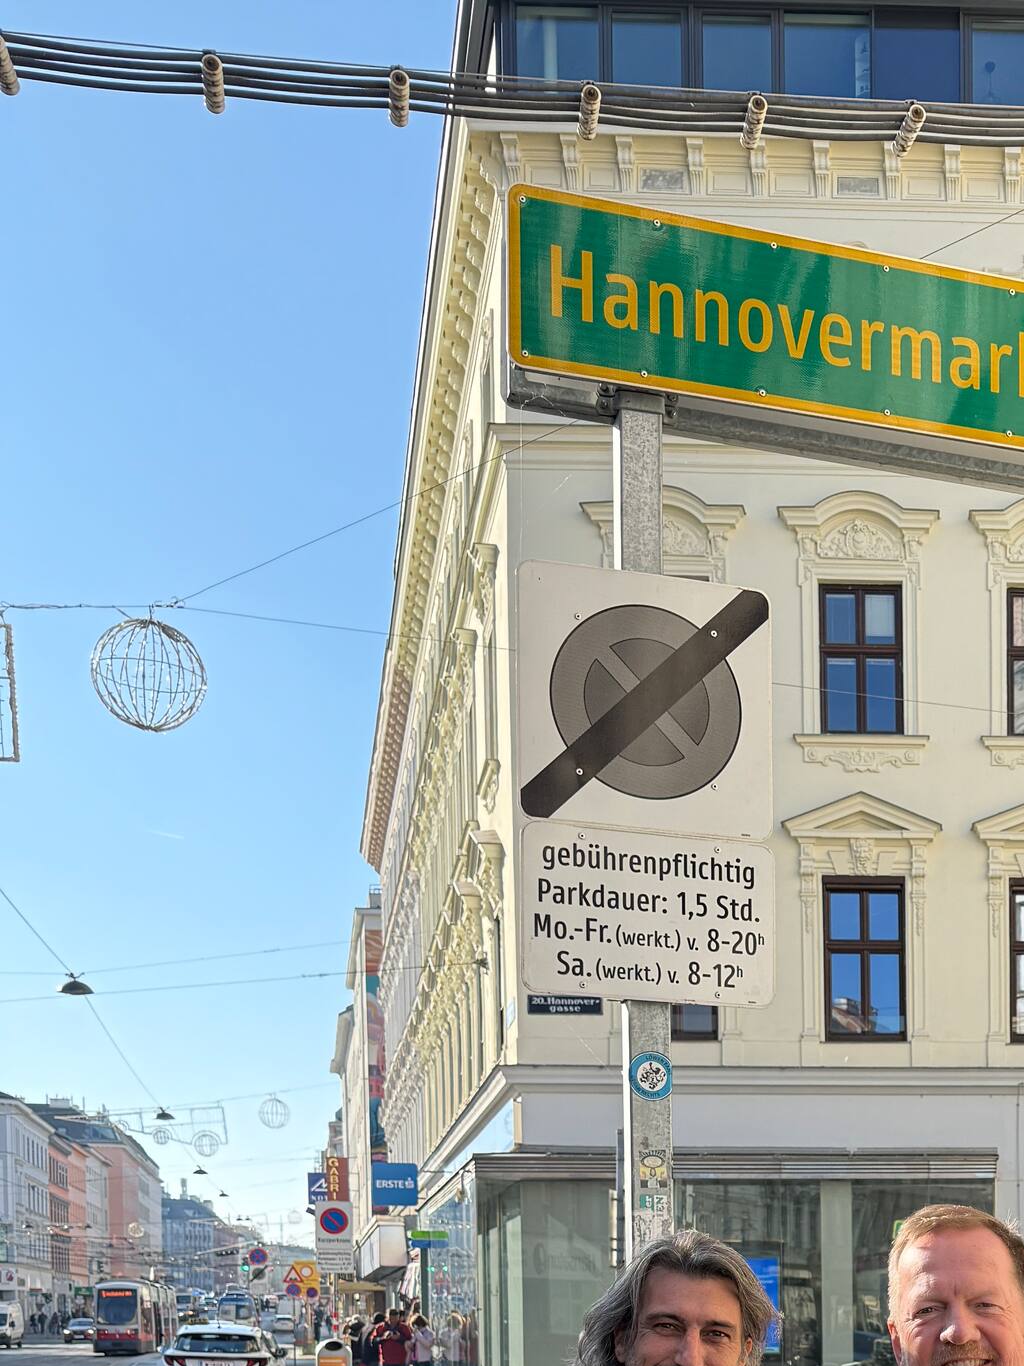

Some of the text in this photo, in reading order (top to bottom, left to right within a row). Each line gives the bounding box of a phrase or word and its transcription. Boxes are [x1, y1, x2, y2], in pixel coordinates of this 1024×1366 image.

[542, 842, 755, 890] gebührenpflichtig
[537, 877, 760, 923] Parkdauer: 1,5 Std.
[686, 935, 699, 951] v.
[667, 969, 680, 985] v.
[549, 1005, 581, 1013] gasse
[375, 1179, 405, 1189] ERSTE
